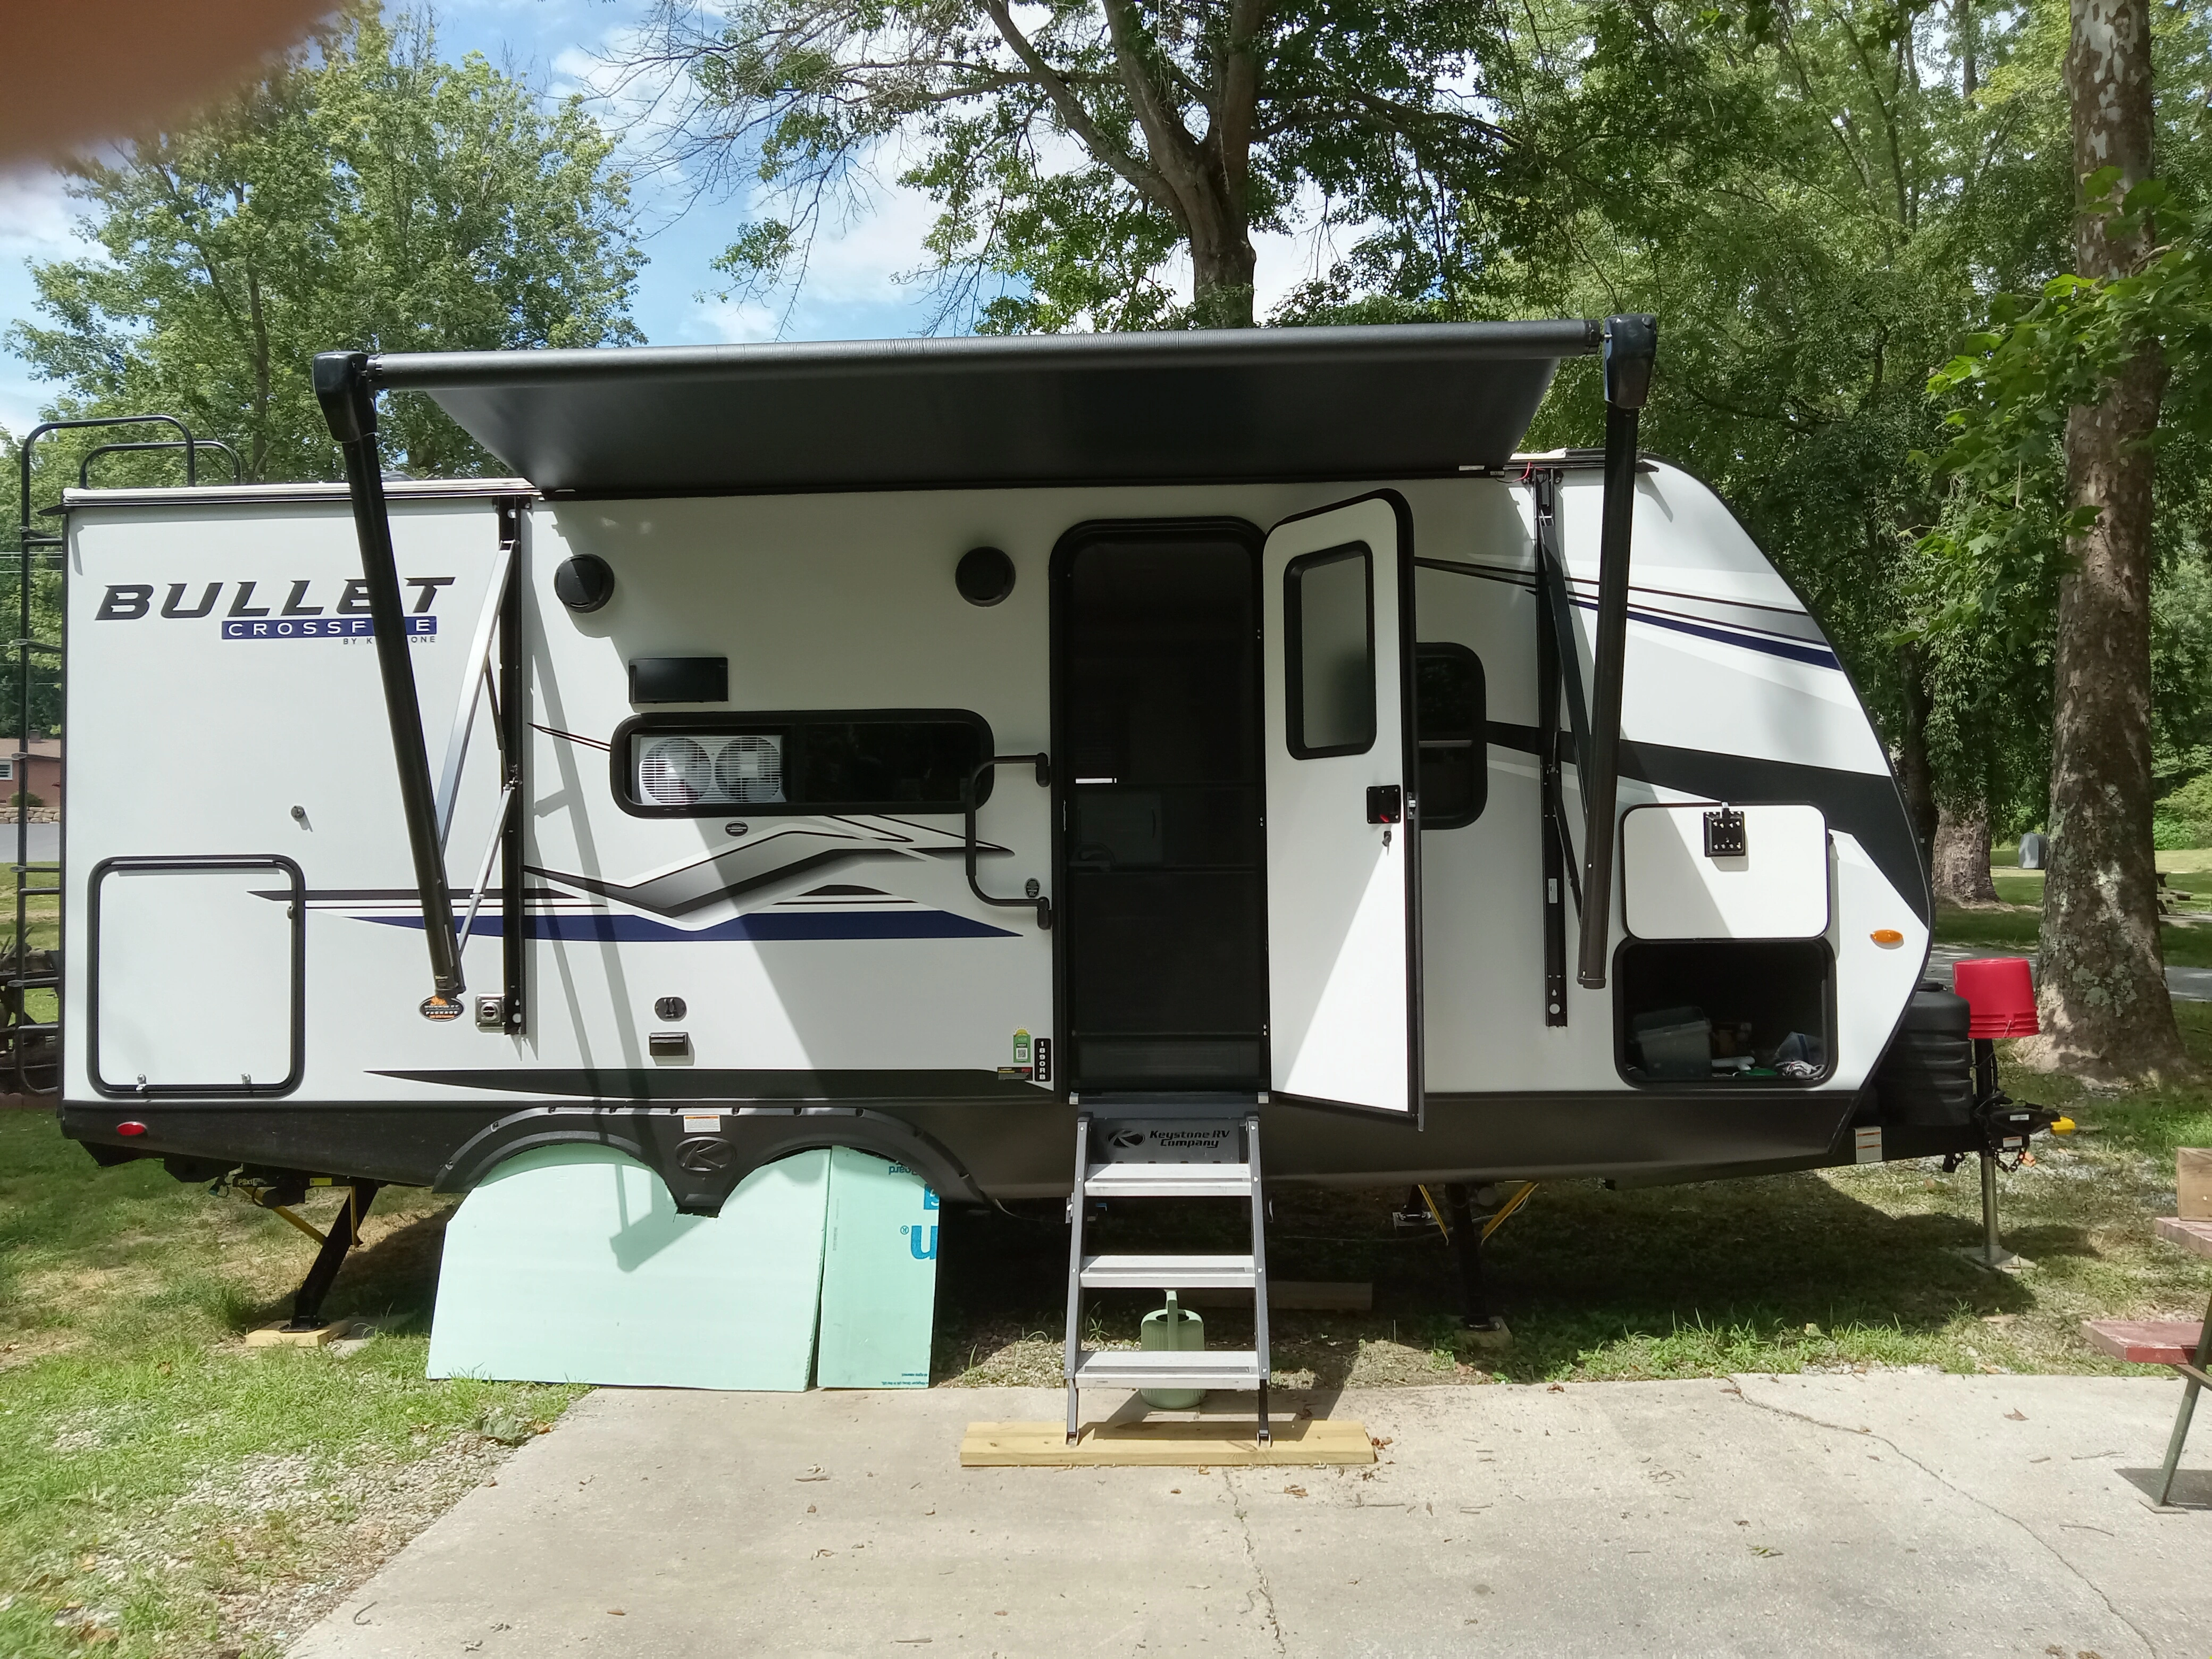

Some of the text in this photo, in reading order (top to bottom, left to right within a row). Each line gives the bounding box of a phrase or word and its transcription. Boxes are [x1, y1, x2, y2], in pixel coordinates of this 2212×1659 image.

[95, 576, 456, 621] BULLET
[228, 619, 430, 636] CROSSFE
[1150, 1130, 1210, 1139] Keystone
[1160, 1139, 1219, 1148] Company
